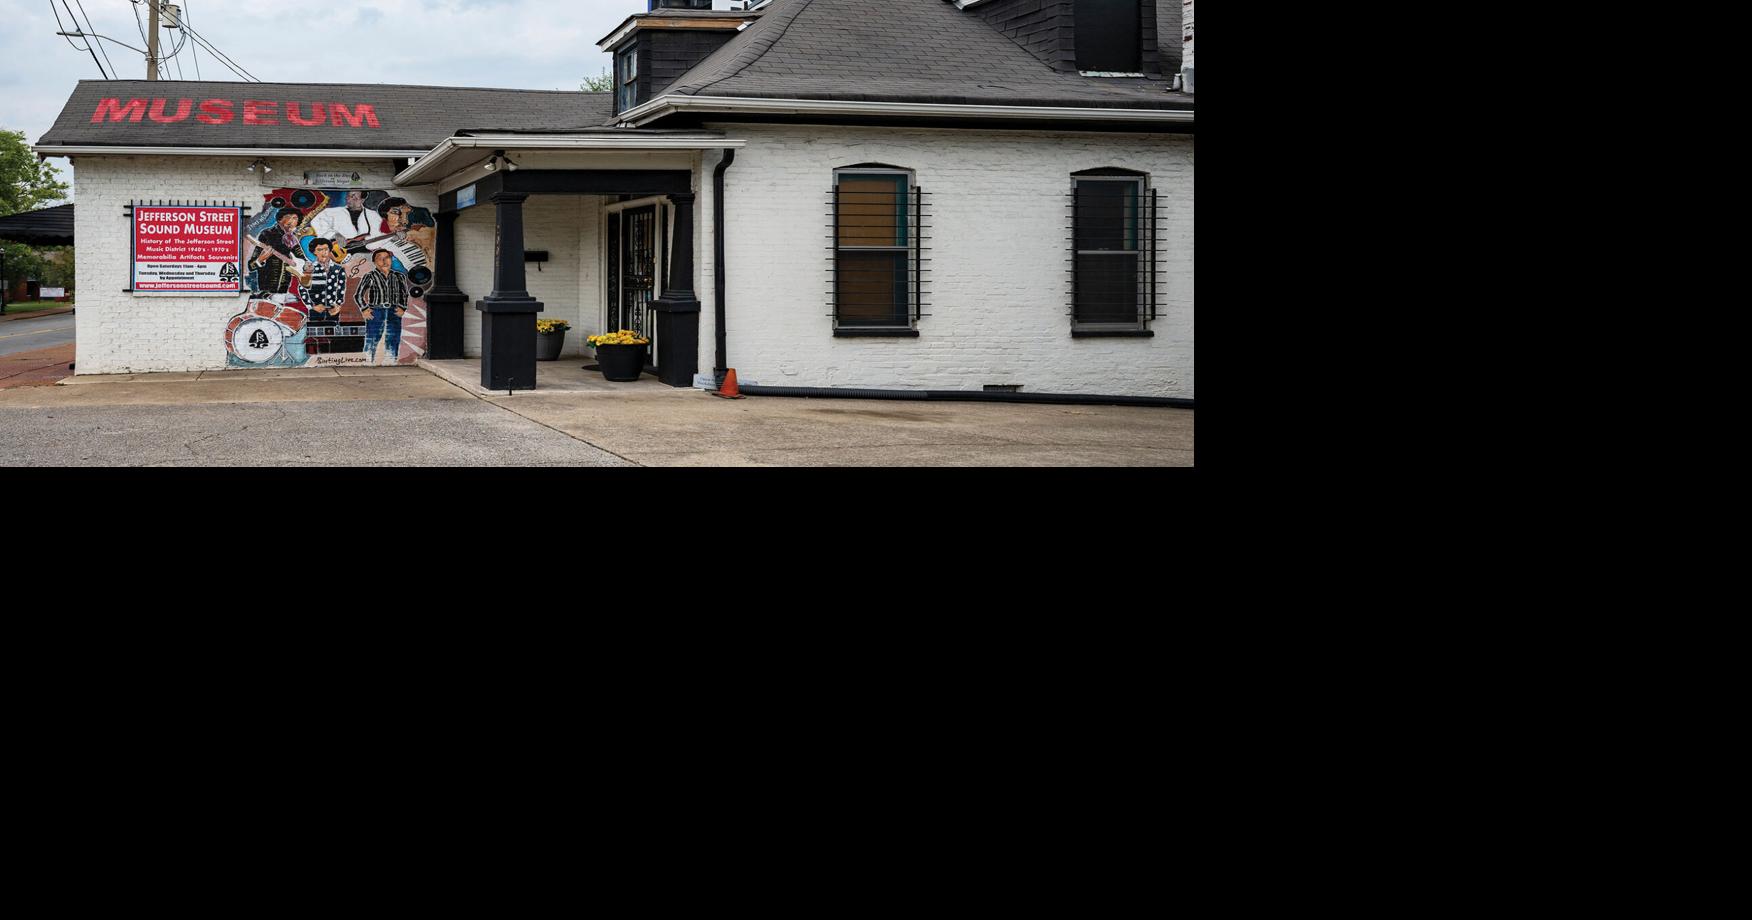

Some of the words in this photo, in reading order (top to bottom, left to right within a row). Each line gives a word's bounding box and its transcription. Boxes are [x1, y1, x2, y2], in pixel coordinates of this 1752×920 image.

[90, 97, 381, 129] MUSEUM
[138, 210, 196, 222] JEFFERSON
[200, 211, 234, 222] STREET
[140, 223, 180, 234] SOUND
[184, 223, 232, 235] MUSEUM
